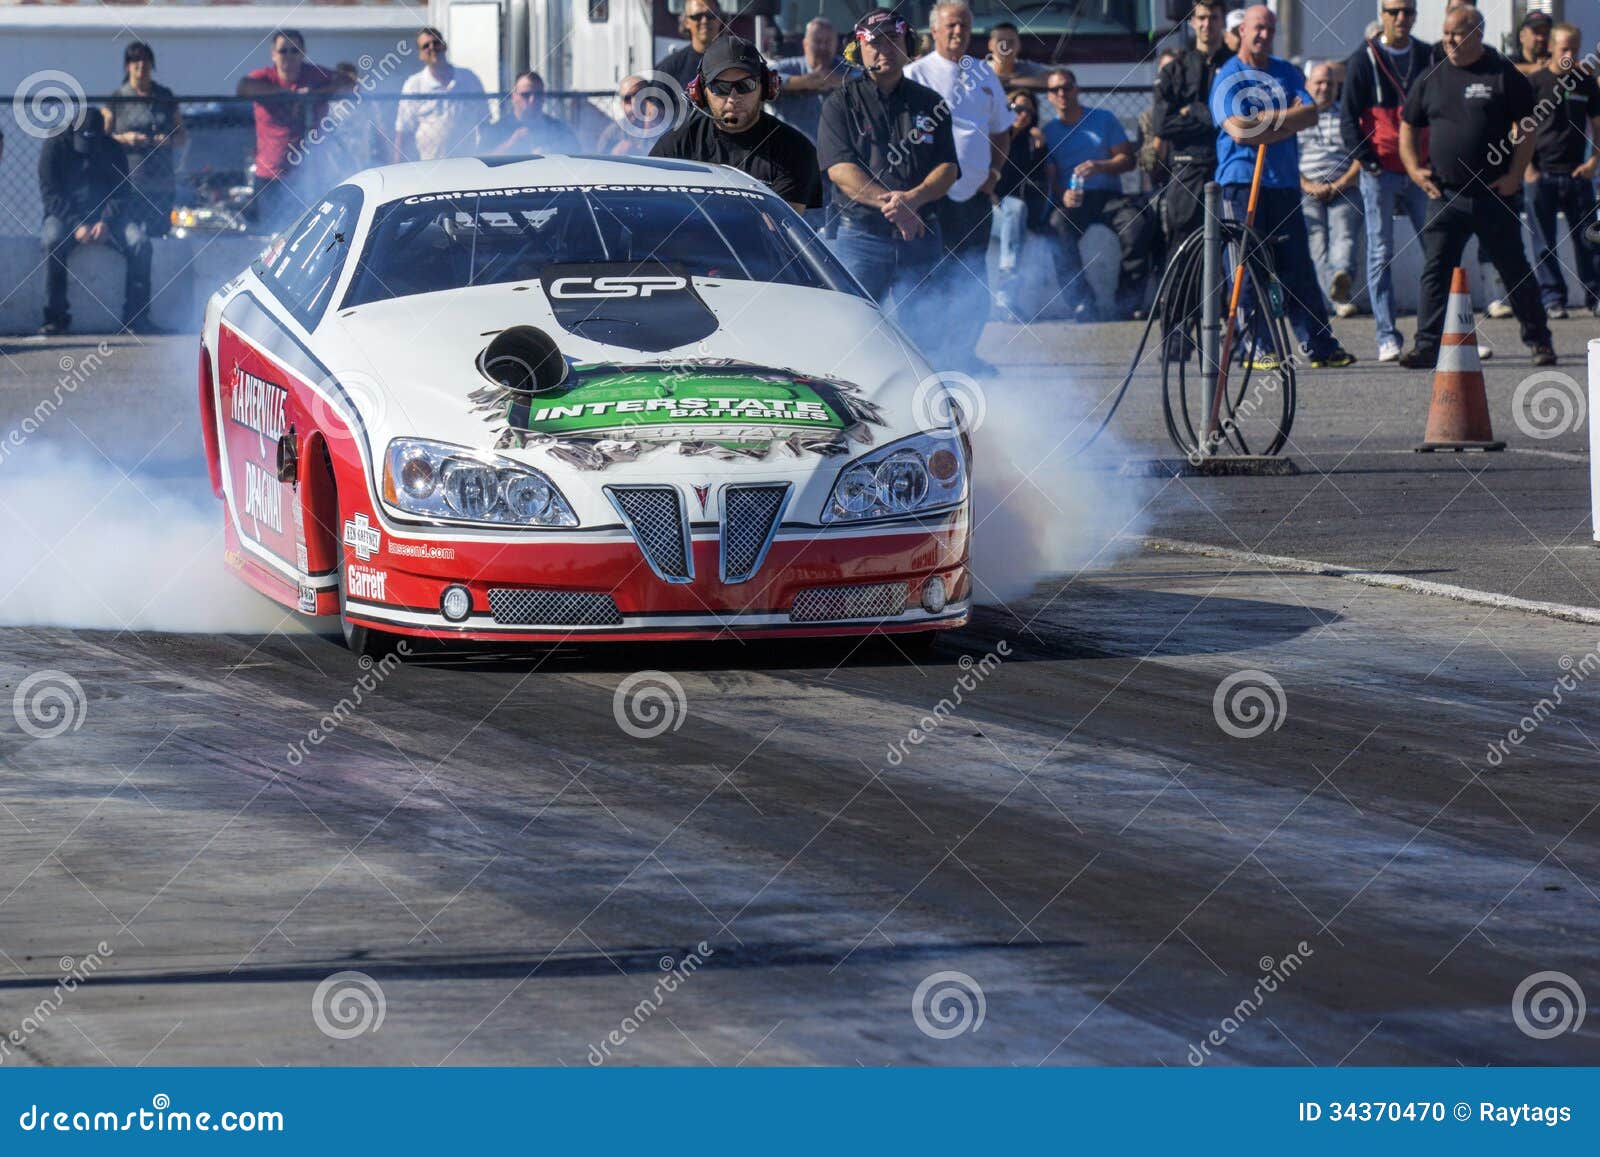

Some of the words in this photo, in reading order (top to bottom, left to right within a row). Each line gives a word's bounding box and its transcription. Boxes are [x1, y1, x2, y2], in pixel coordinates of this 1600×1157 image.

[550, 277, 687, 298] CSP
[534, 397, 822, 422] INTERSTATE
[669, 408, 829, 421] BATTERIES
[348, 564, 386, 600] Garrett
